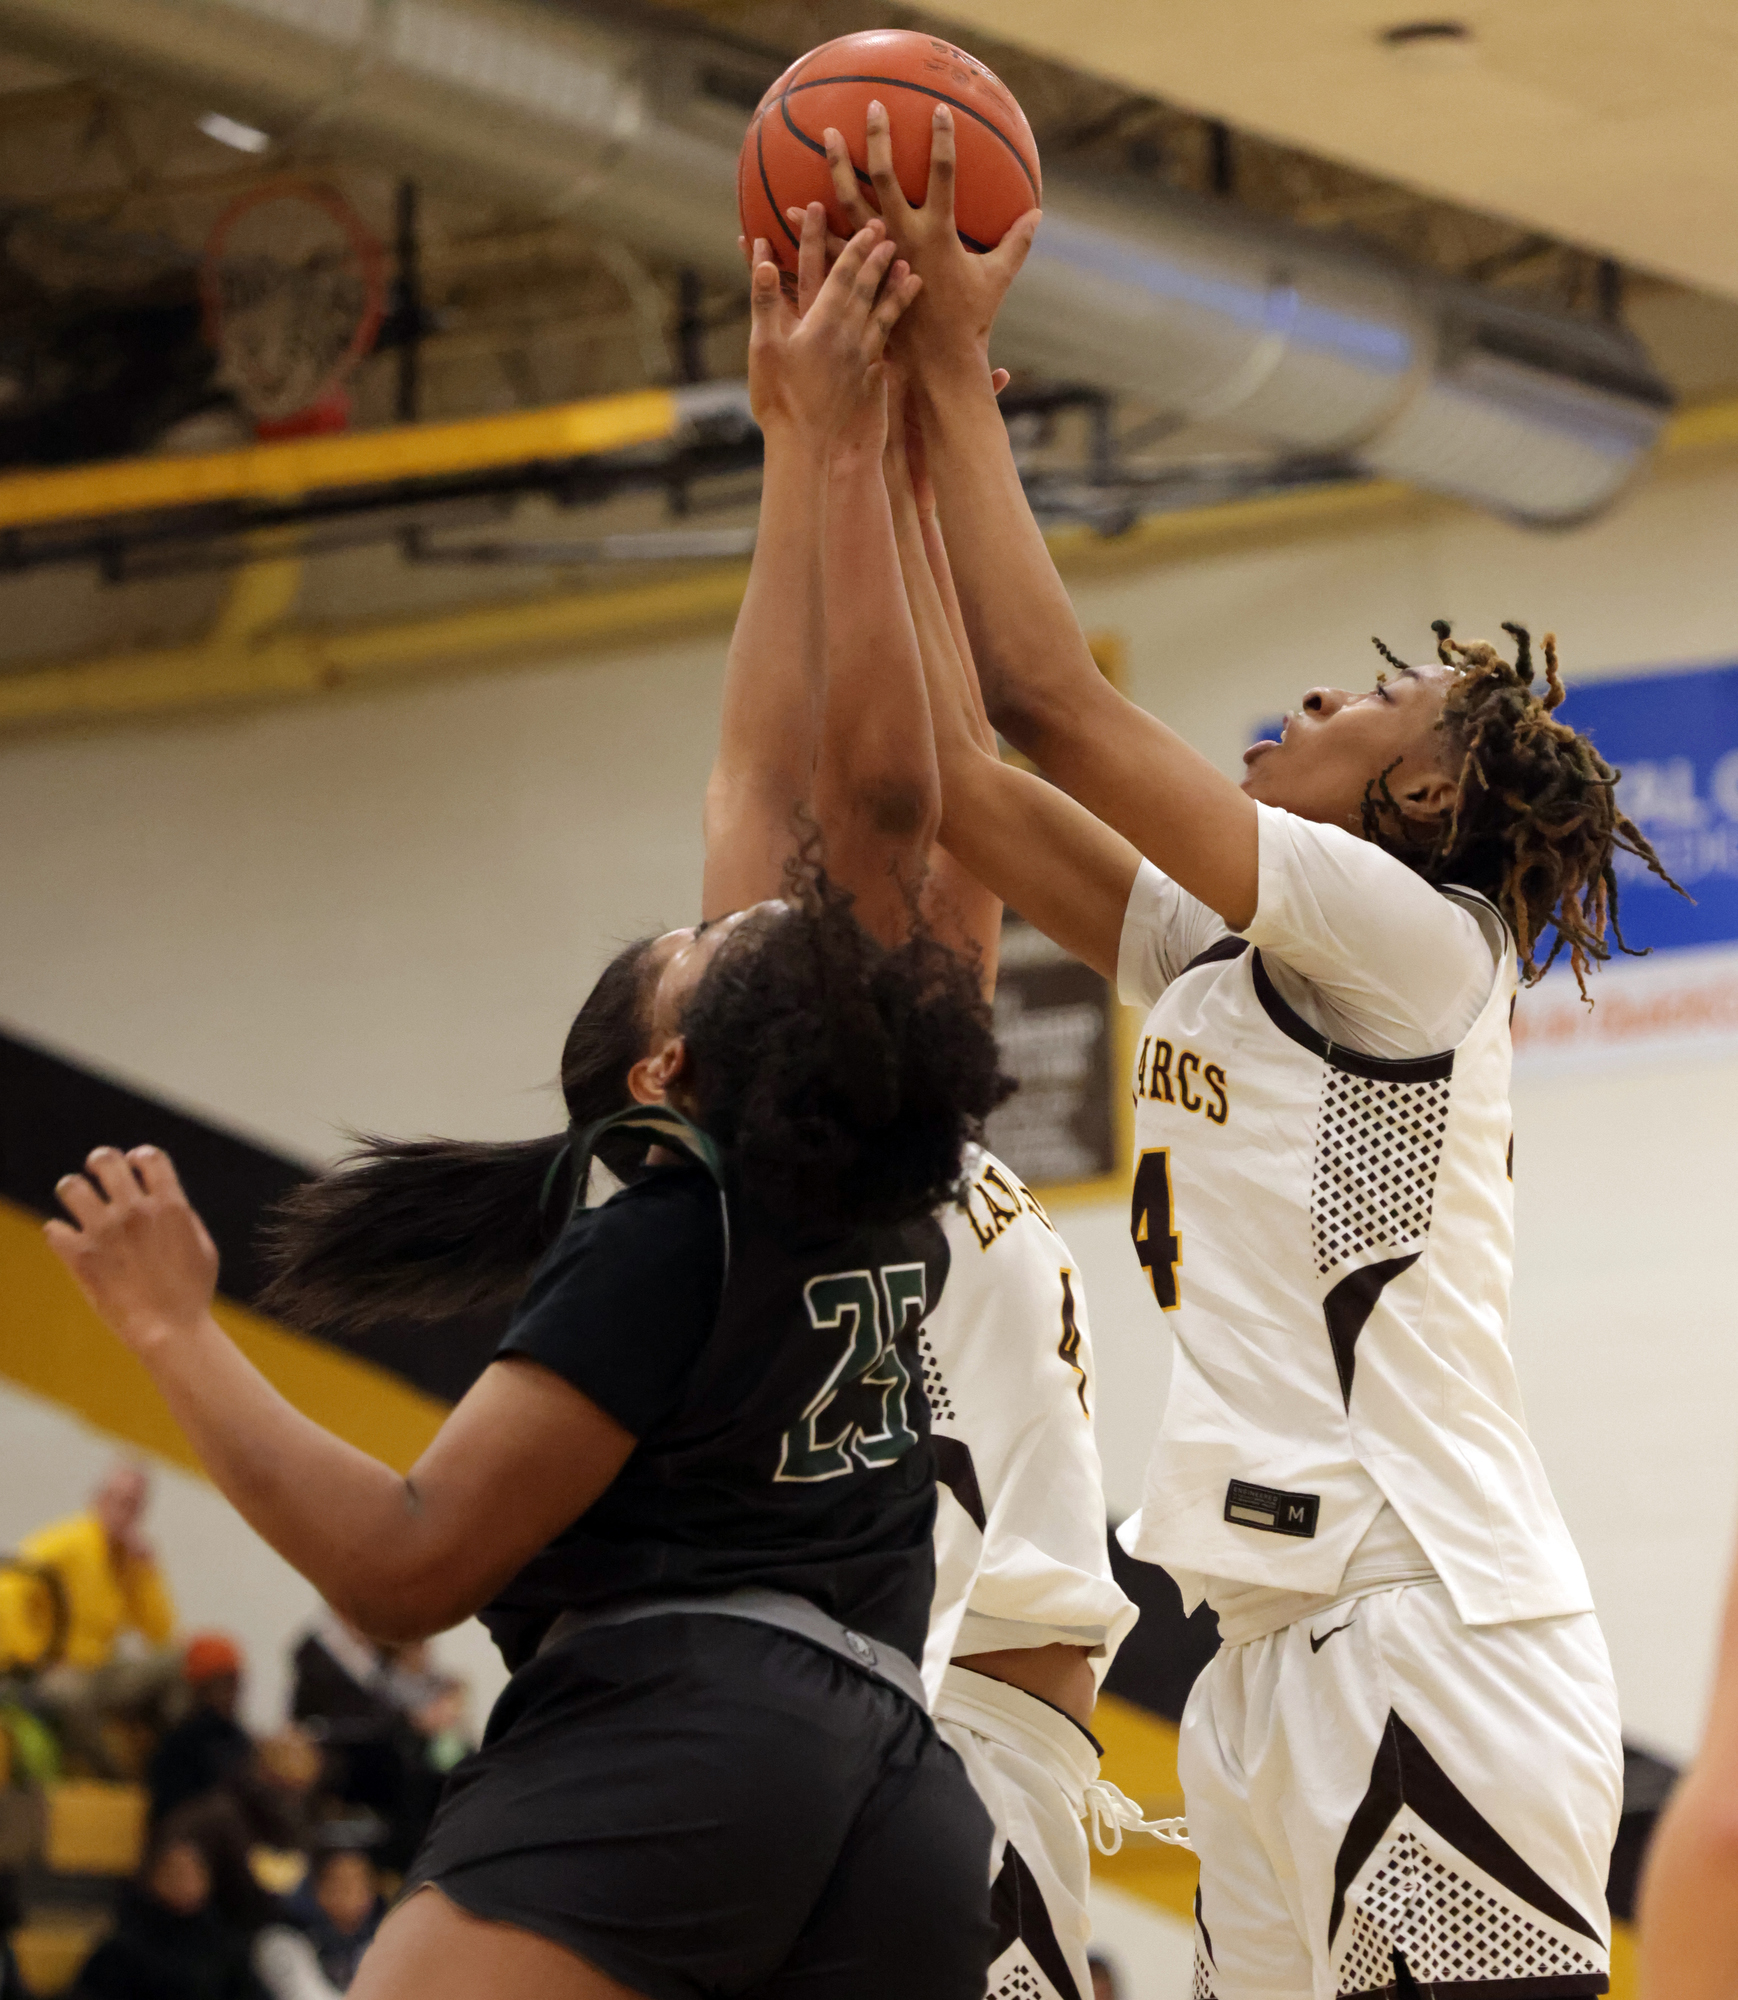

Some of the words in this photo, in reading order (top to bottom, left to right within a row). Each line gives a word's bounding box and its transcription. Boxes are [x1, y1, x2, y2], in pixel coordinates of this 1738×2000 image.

[1131, 1146, 1183, 1312] 4
[772, 1261, 926, 1482] 25
[1288, 1505, 1305, 1523] M
